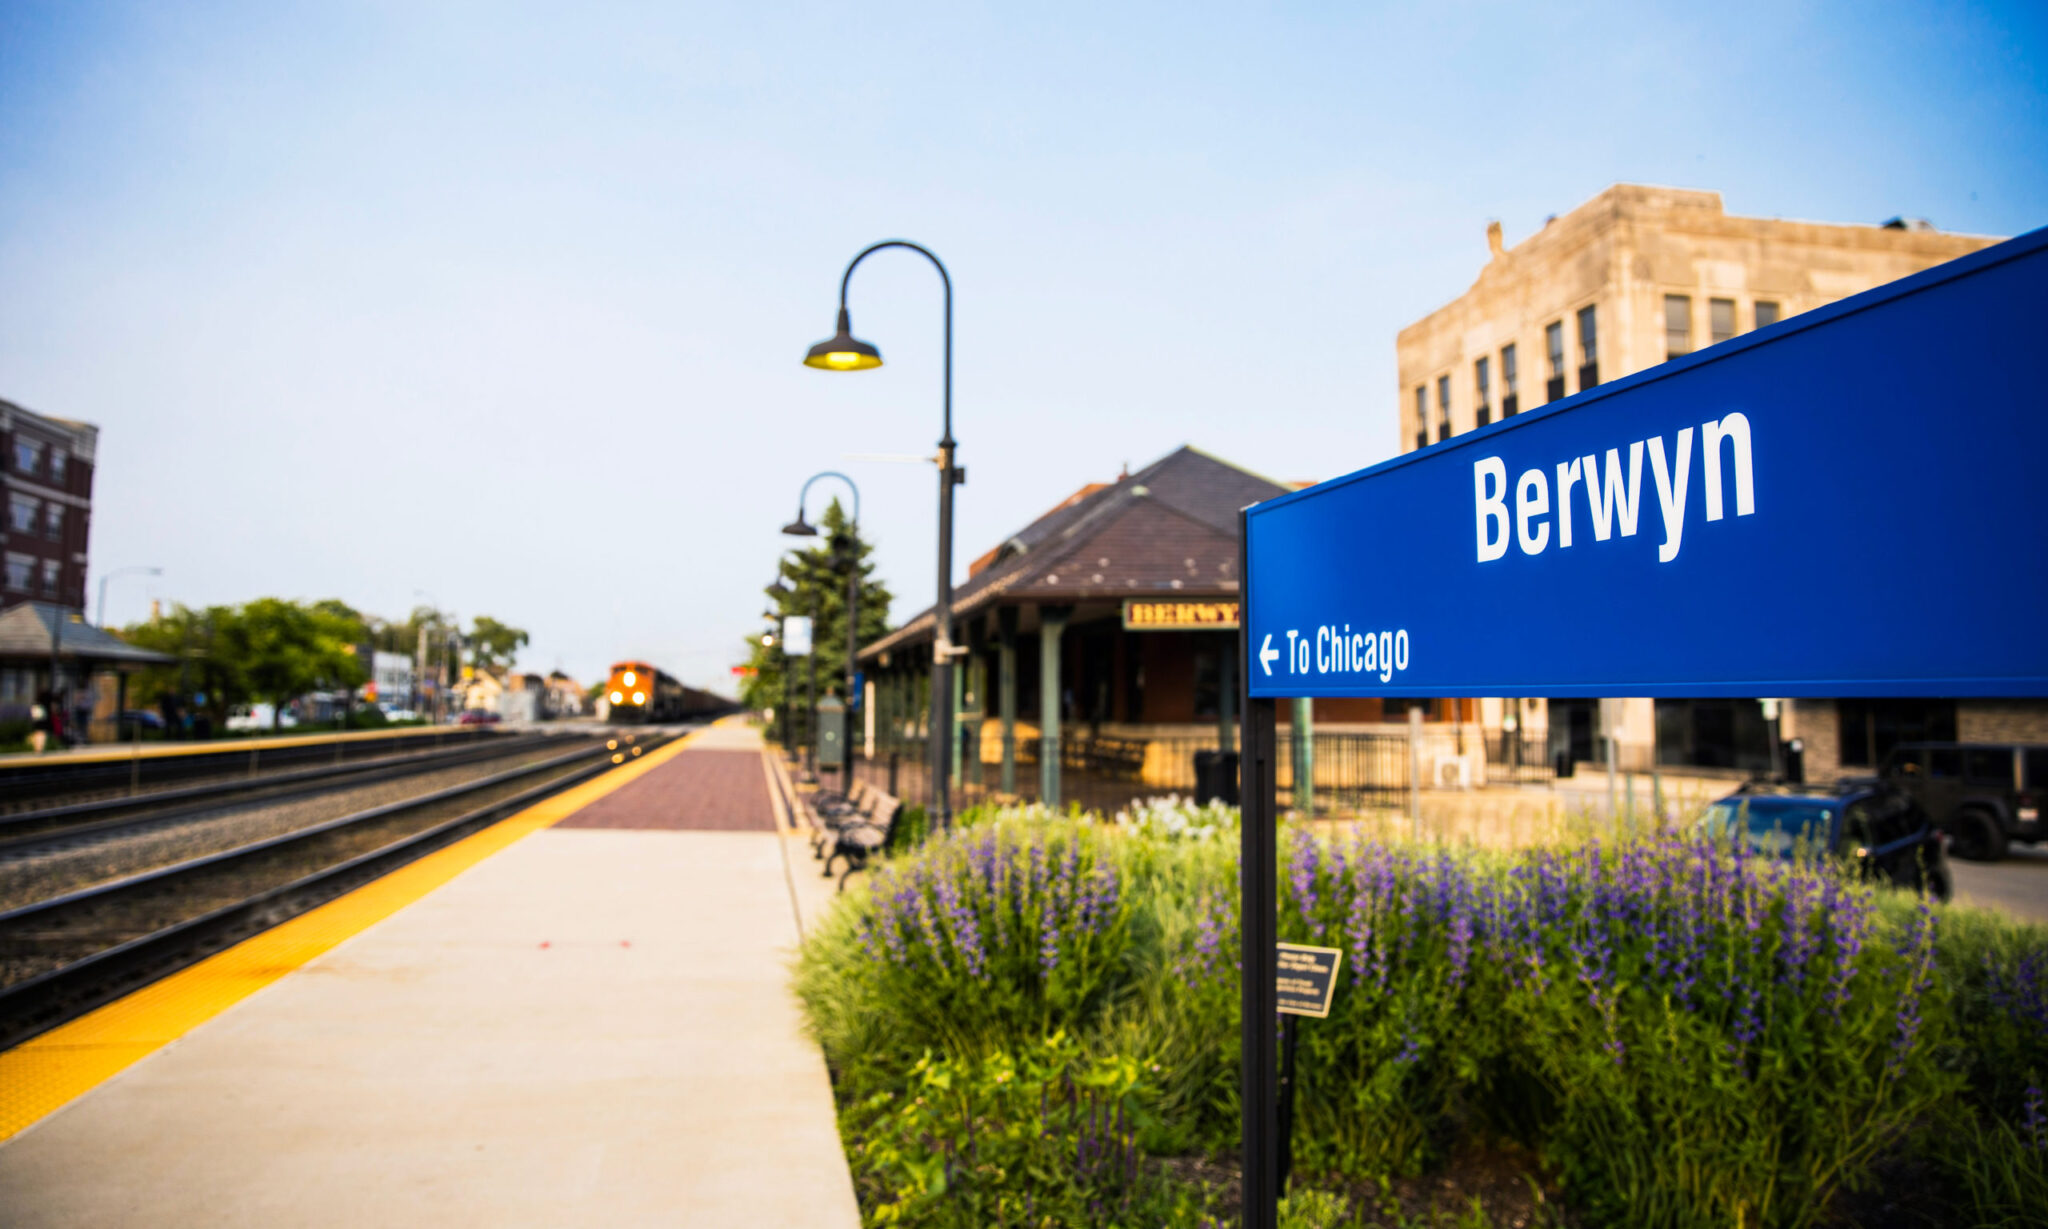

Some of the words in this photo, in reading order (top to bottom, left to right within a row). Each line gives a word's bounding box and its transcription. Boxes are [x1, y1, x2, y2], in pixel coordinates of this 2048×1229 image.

[1474, 412, 1755, 563] Berwyn
[1133, 603, 1239, 623] BERWY
[1286, 629, 1310, 675] To
[1316, 624, 1409, 683] Chicago
